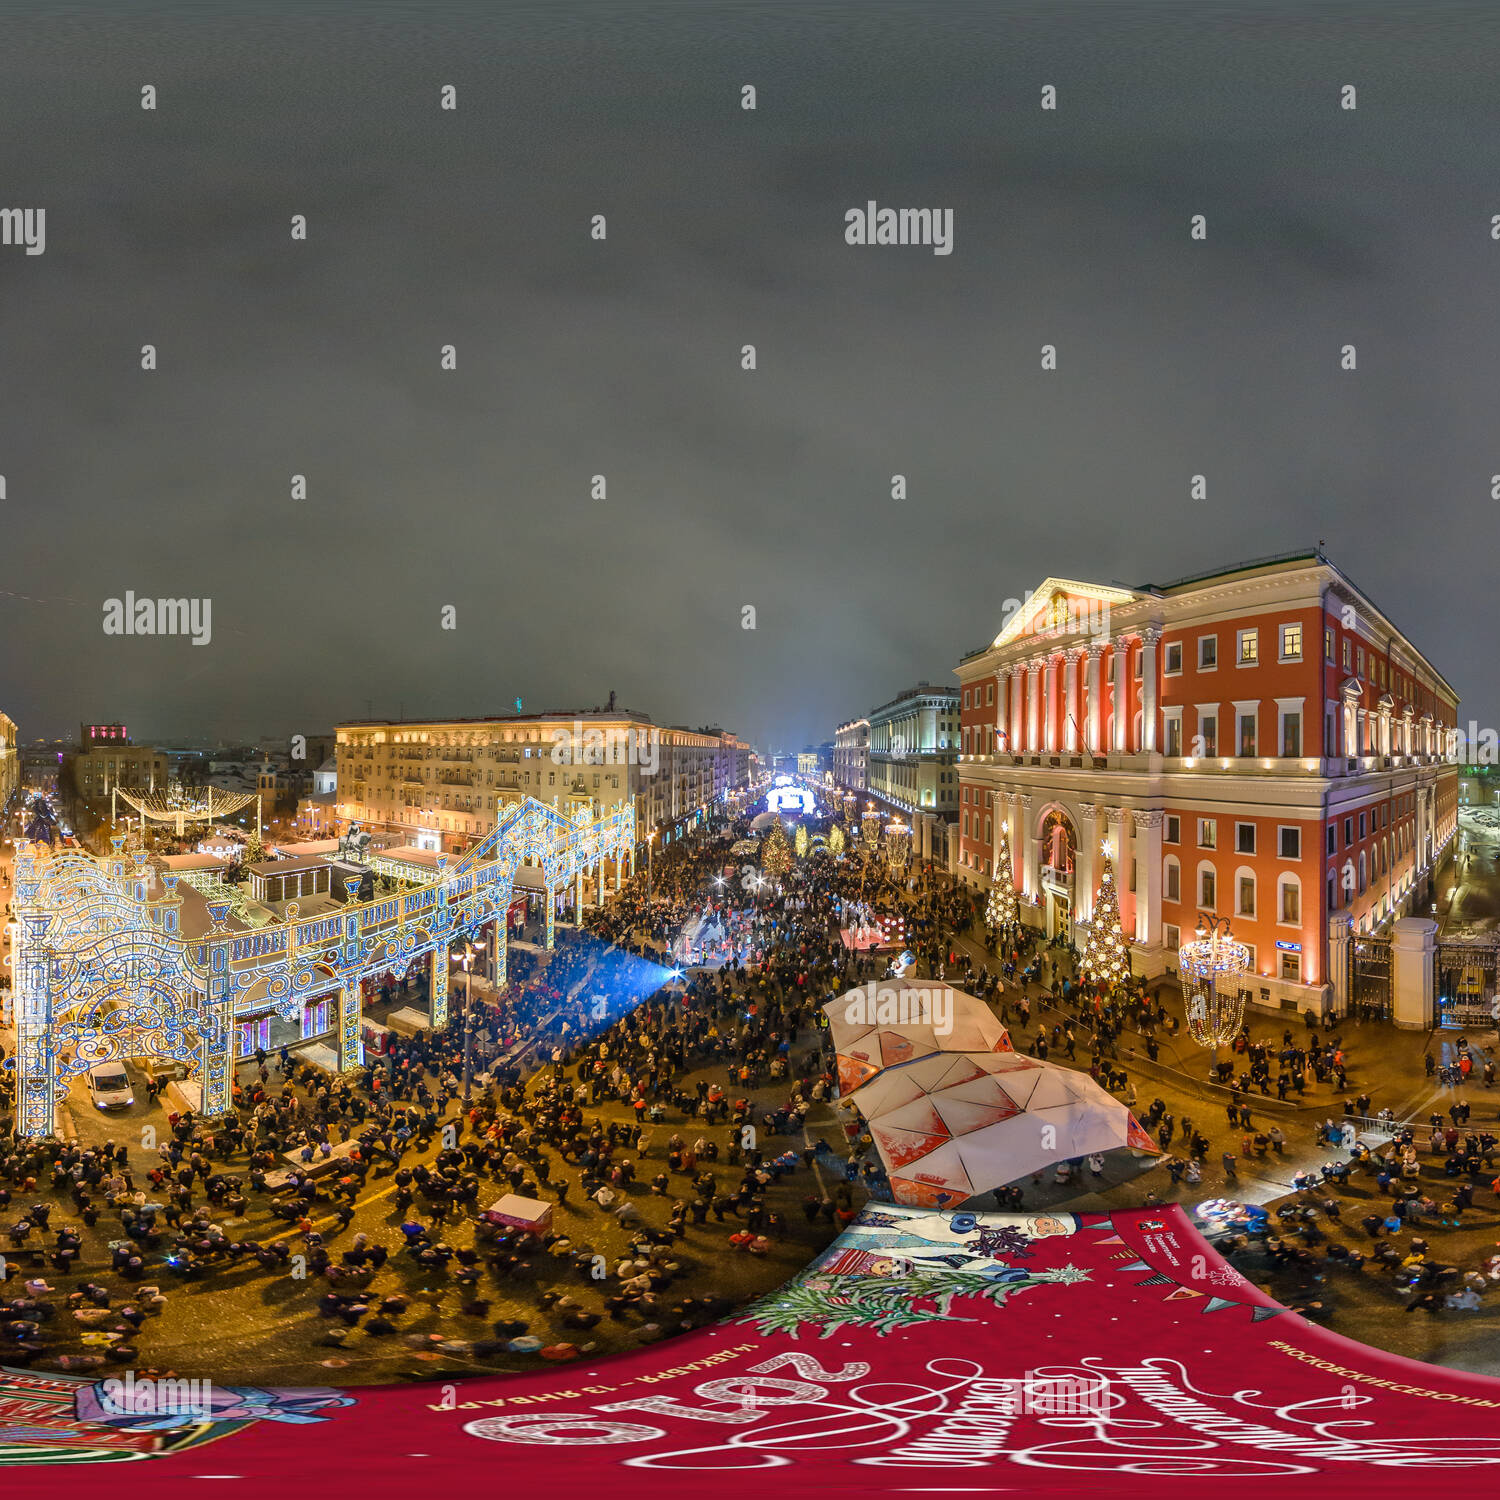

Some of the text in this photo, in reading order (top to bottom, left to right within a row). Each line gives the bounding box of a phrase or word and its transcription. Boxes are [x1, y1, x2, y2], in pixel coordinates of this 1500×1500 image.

[636, 1349, 739, 1384] ДЕКАБРЯ
[463, 1352, 871, 1447] 2019
[581, 1384, 619, 1395] 13
